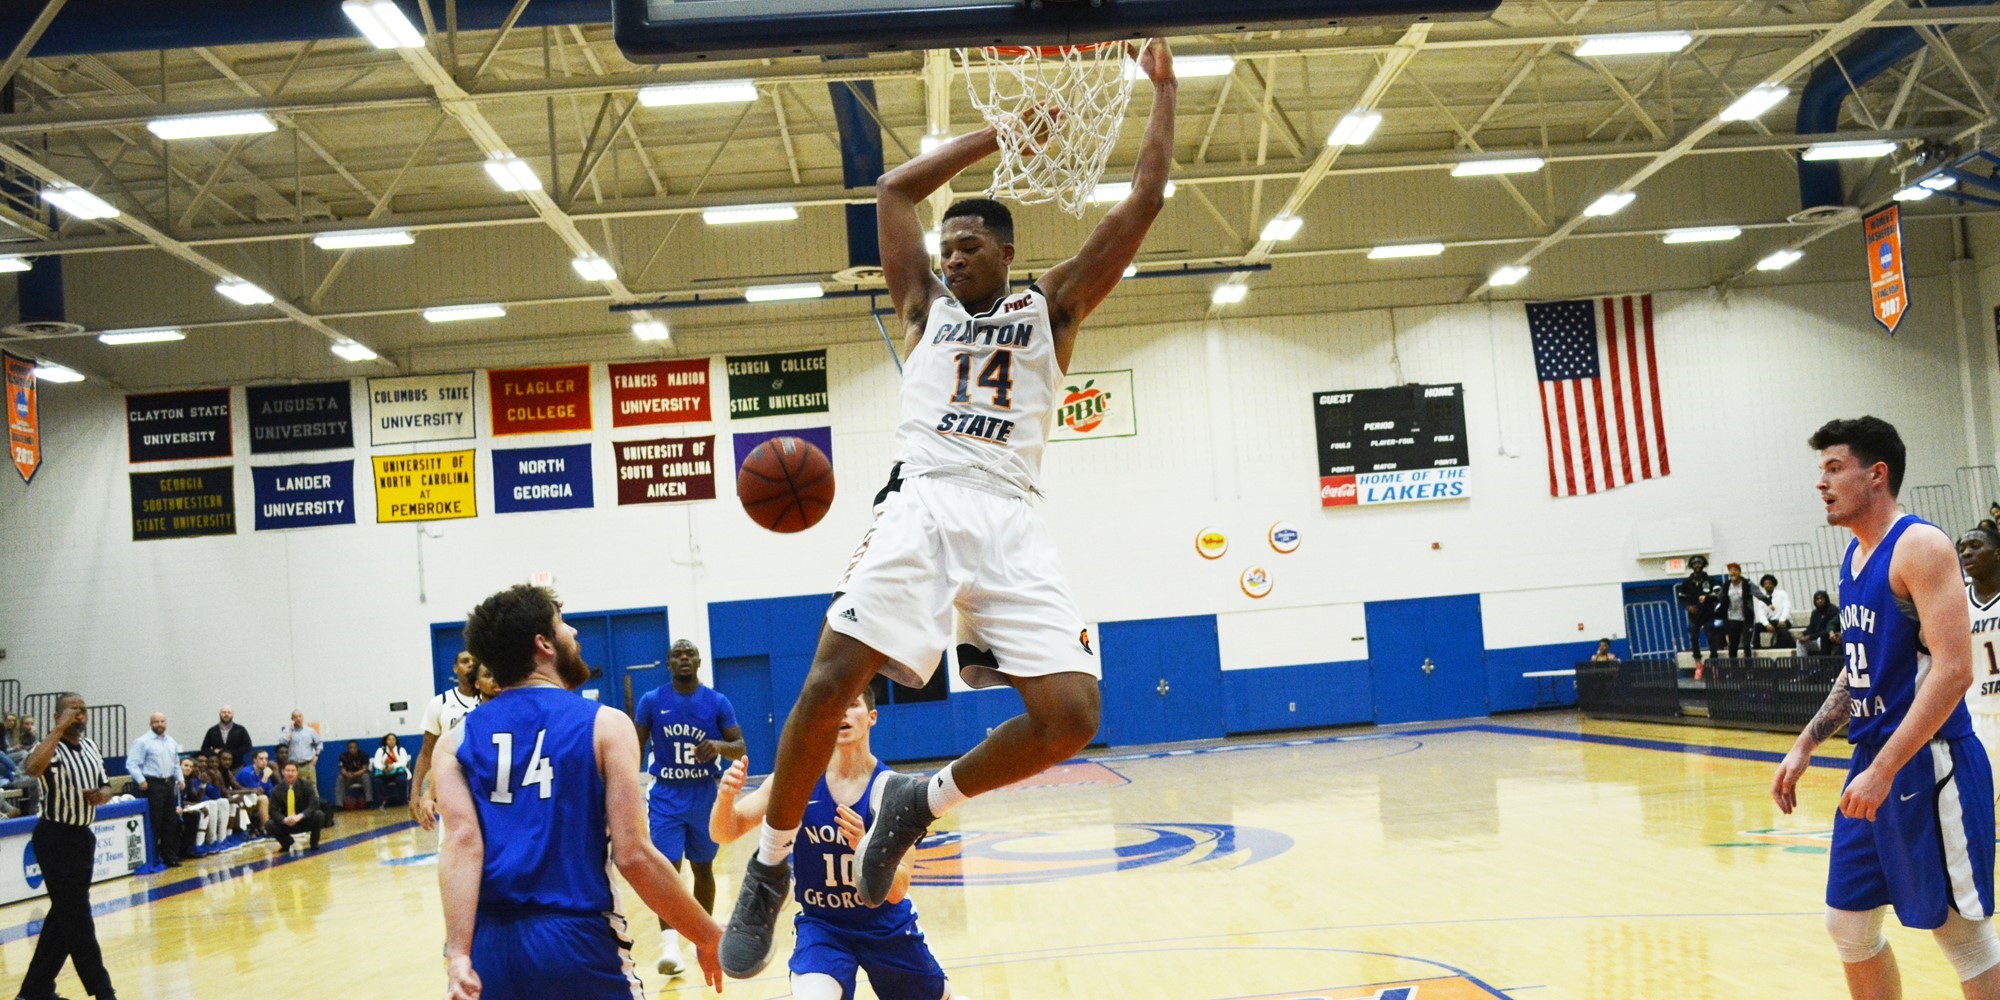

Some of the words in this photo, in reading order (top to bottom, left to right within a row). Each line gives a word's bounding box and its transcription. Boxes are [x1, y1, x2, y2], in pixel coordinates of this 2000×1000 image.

[1004, 294, 1032, 313] PBC
[932, 320, 1033, 348] CLAYTON
[728, 360, 770, 375] GEORGIA
[781, 357, 826, 372] COLLEGE
[615, 374, 657, 389] FRANCIS
[668, 371, 705, 386] MARION
[950, 349, 1013, 409] 14
[374, 388, 428, 403] COLUMBUS
[439, 387, 469, 401] STATE
[505, 380, 575, 396] FLAGLER
[1424, 386, 1455, 398] HOME
[262, 397, 338, 415] AUGUSTA
[621, 397, 701, 414] UNIVERSITY
[730, 397, 760, 413] STATE
[769, 392, 827, 409] UNIVERSITY
[1319, 394, 1354, 405] GUEST
[130, 408, 184, 422] CLAYTON
[190, 405, 228, 418] STATE
[507, 405, 576, 422] COLLEGE
[1057, 392, 1111, 427] PBC
[381, 413, 463, 430] UNIVERSITY
[937, 412, 1015, 445] STATE
[1364, 421, 1395, 431] PERIOD
[143, 431, 216, 446] UNIVERSITY
[255, 421, 347, 440] UNIVERSITY
[623, 444, 684, 461] UNIVERSITY
[692, 441, 706, 456] OF
[383, 457, 442, 473] UNIVERSITY
[452, 456, 464, 469] OF
[519, 459, 565, 475] NORTH
[620, 465, 653, 480] SOUTH
[662, 461, 712, 478] CAROLINA
[160, 477, 203, 491] GEORGIA
[276, 475, 331, 491] LANDER
[380, 474, 411, 488] NORTH
[421, 471, 470, 486] CAROLINA
[1359, 473, 1406, 485] HOME
[1411, 471, 1430, 481] OF
[1438, 468, 1468, 479] THE
[420, 490, 430, 499] AT
[513, 483, 572, 500] GEORGIA
[647, 482, 687, 498] AIKEN
[1367, 481, 1463, 502] LAKERS
[143, 495, 223, 512] SOUTHWESTERN
[263, 500, 345, 518] UNIVERSITY
[391, 501, 462, 517] PEMBROKE
[136, 518, 166, 532] STATE
[173, 514, 233, 531] UNIVERSITY
[1981, 681, 2000, 696] STA
[663, 723, 706, 741] NORTH
[673, 741, 696, 765] 12
[490, 729, 554, 804] 14
[660, 766, 709, 780] GEORGIA
[94, 825, 115, 834] Home
[804, 824, 849, 846] NOR
[822, 853, 857, 887] 10
